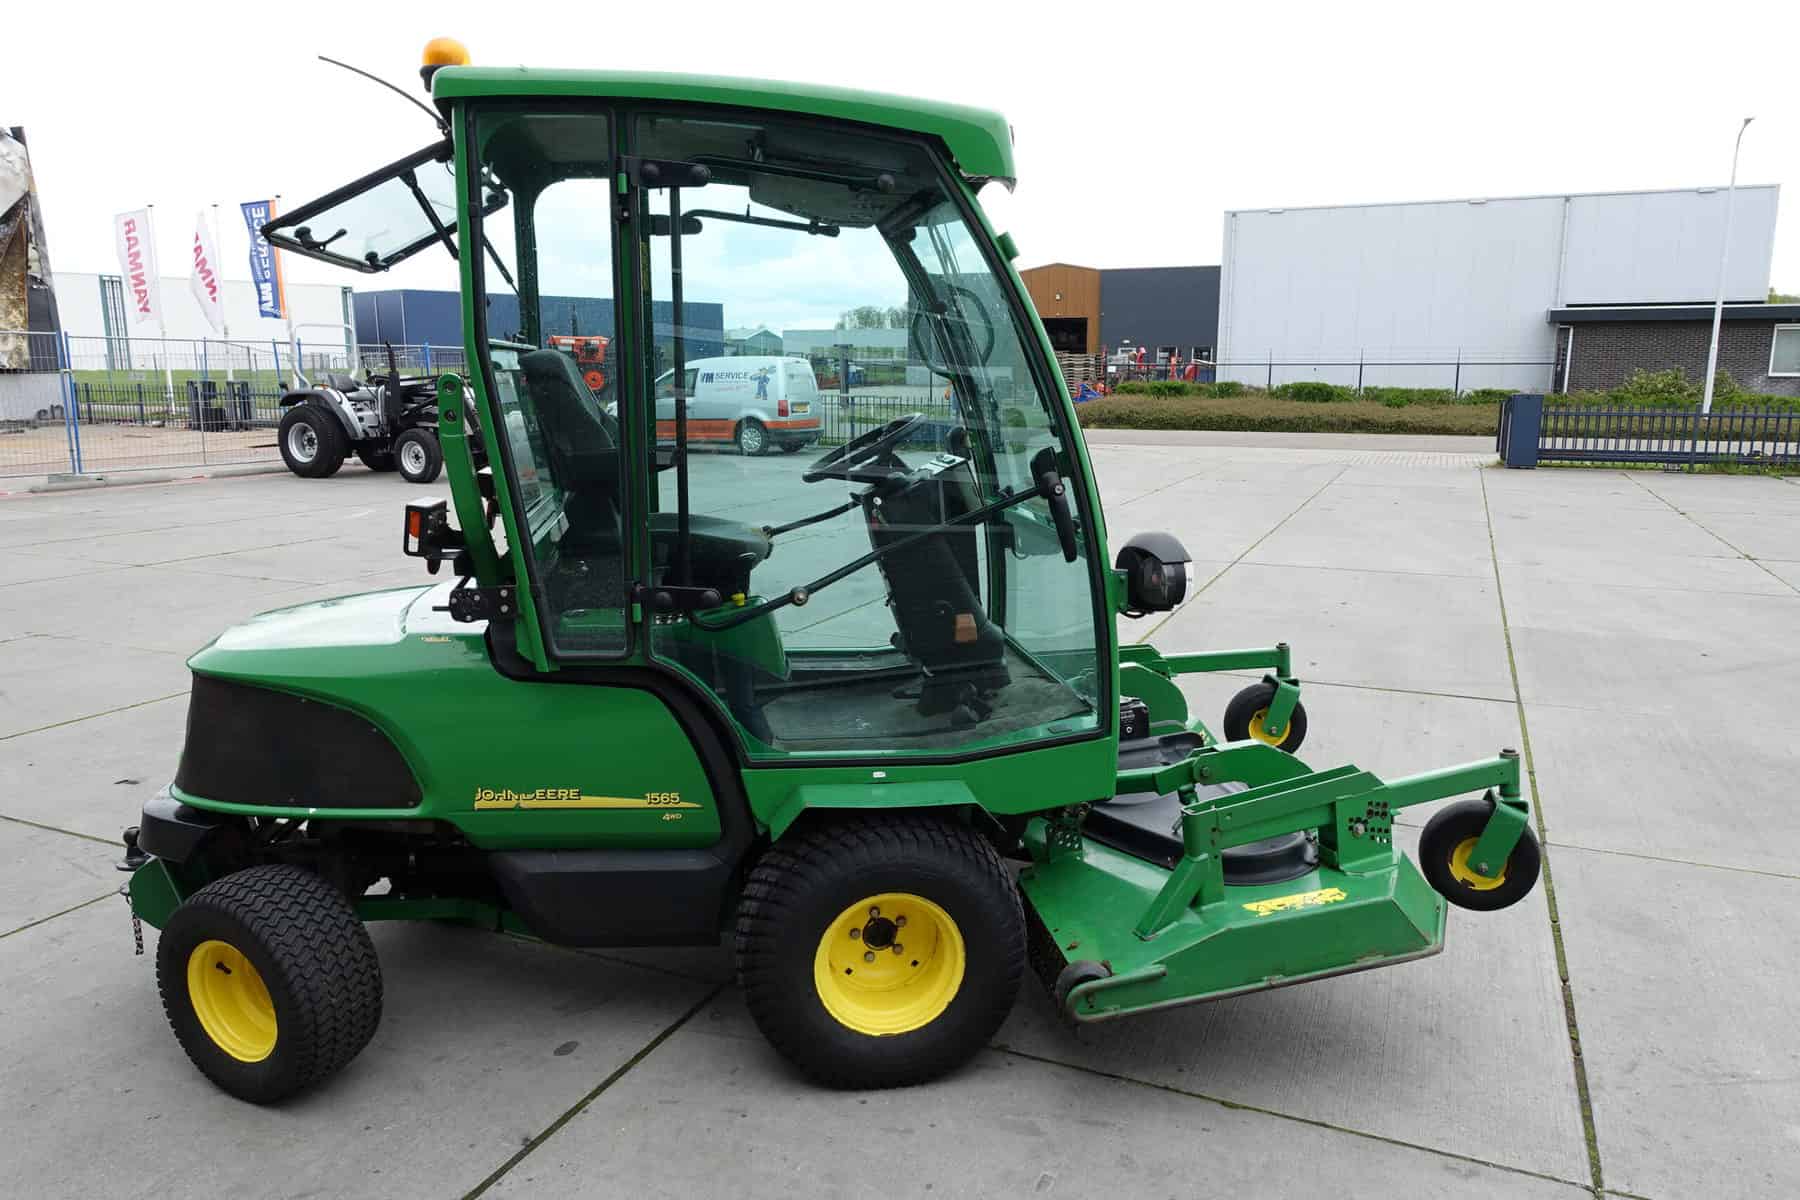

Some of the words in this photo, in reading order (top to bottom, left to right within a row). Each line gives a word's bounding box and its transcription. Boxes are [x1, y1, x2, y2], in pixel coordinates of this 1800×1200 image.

[715, 370, 749, 380] SERVICE
[475, 786, 521, 801] JOHN
[645, 792, 680, 804] 1565
[661, 812, 682, 821] 4WD
